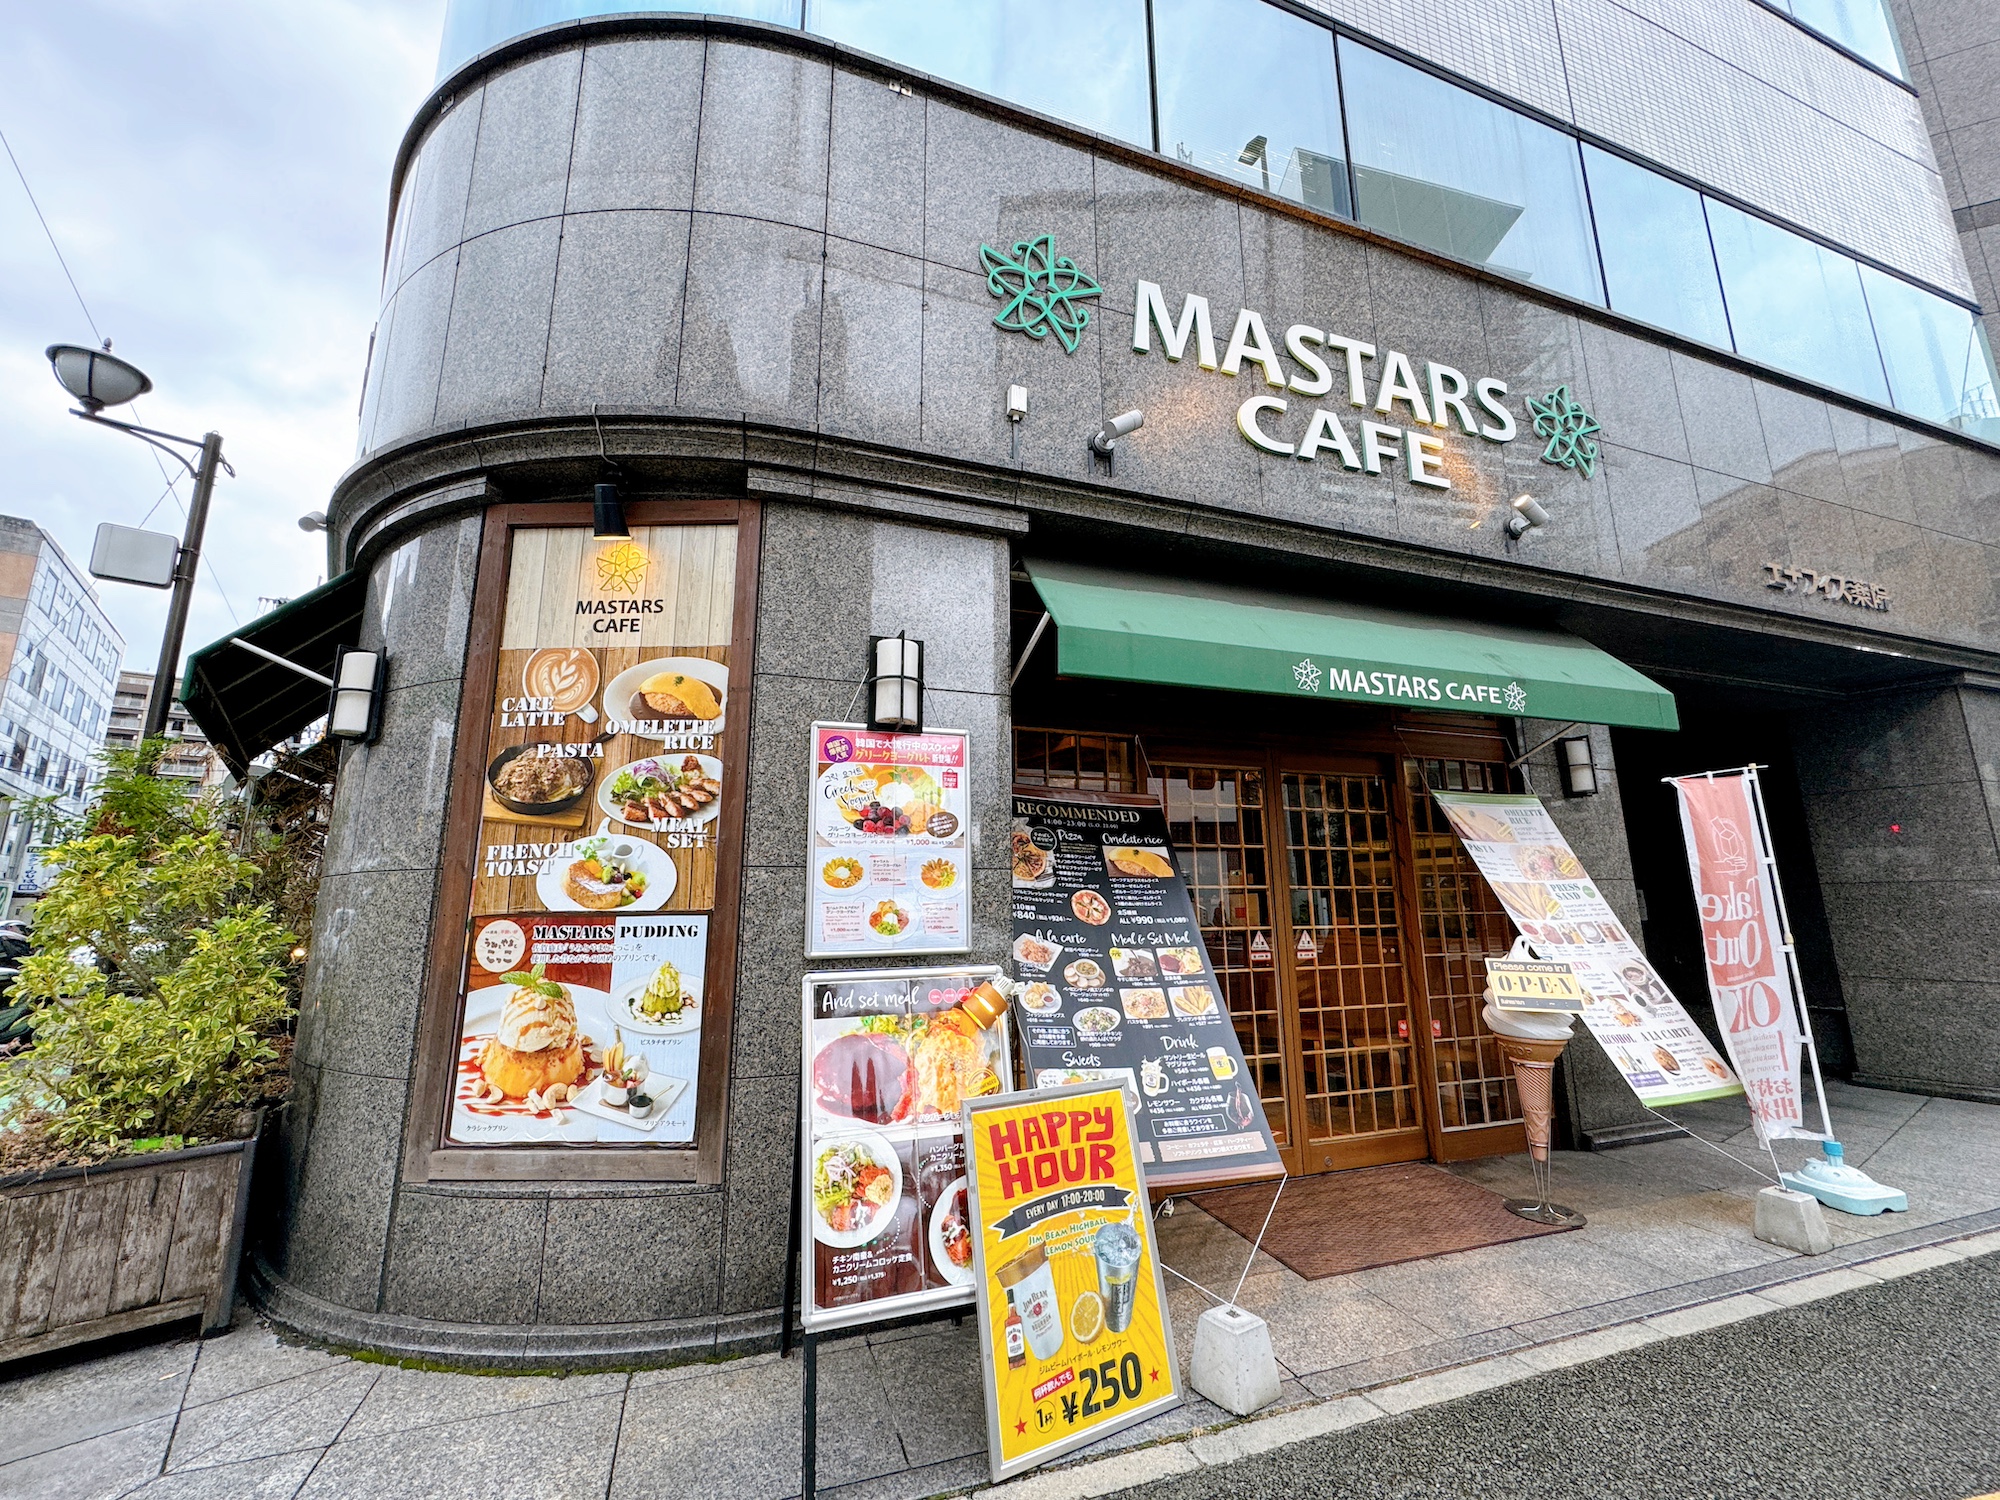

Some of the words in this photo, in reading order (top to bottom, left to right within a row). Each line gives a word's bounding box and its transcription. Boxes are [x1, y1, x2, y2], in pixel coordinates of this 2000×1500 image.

[1133, 279, 1517, 443] MASTARS
[1237, 395, 1450, 490] CAFE
[576, 599, 664, 615] MASTARS
[593, 618, 640, 633] CAFE
[1329, 667, 1442, 701] MASTARS
[1446, 683, 1503, 704] CAFE
[501, 697, 554, 713] CAFE
[500, 712, 565, 727] LATTE
[605, 720, 715, 736] OMELETTE
[536, 743, 604, 758] PASTA
[663, 736, 714, 750] RICE
[824, 780, 857, 800] Greek
[1016, 801, 1140, 823] RECOMMENDED
[650, 817, 708, 833] MEAL
[1509, 817, 1532, 825] RICE
[667, 833, 707, 849] SET
[1056, 828, 1084, 842] Pizza
[1102, 832, 1143, 845] Omelette
[486, 843, 574, 861] FRENCH
[1466, 843, 1495, 854] PASTA
[485, 859, 554, 878] TOAST
[1551, 883, 1581, 892] PRESS
[1557, 892, 1581, 900] SAND
[1119, 917, 1131, 925] ALL
[1131, 915, 1153, 925] ¥990
[533, 924, 615, 940] MASTARS
[620, 924, 698, 939] PUDDING
[1060, 933, 1087, 945] carte
[1111, 932, 1136, 946] Meal
[1147, 931, 1164, 945] Set
[1165, 931, 1191, 945] Meal
[1492, 961, 1524, 971] Please
[1526, 963, 1554, 972] come
[822, 990, 854, 1012] And
[858, 991, 881, 1008] set
[885, 986, 920, 1006] meal
[1159, 1035, 1199, 1051] Drink
[1061, 1051, 1102, 1067] Sweets
[1146, 1100, 1181, 1108] レモンサワー
[988, 1106, 1115, 1161] HAPPY
[998, 1143, 1116, 1200] HOUR
[1025, 1204, 1045, 1219] EVERY
[1047, 1201, 1059, 1211] DAY
[1060, 1189, 1105, 1207] 17:00-20:00
[1028, 1234, 1043, 1246] JIM
[1045, 1229, 1068, 1241] BEAM
[1069, 1217, 1108, 1232] HIGHBALL
[1044, 1242, 1073, 1256] LEMON
[1075, 1234, 1096, 1247] SOUR
[832, 1274, 858, 1287] ¥1,250
[1033, 1372, 1074, 1401] 何杯飲んでも
[1036, 1408, 1053, 1428] 1杯
[1060, 1351, 1143, 1425] ¥250
